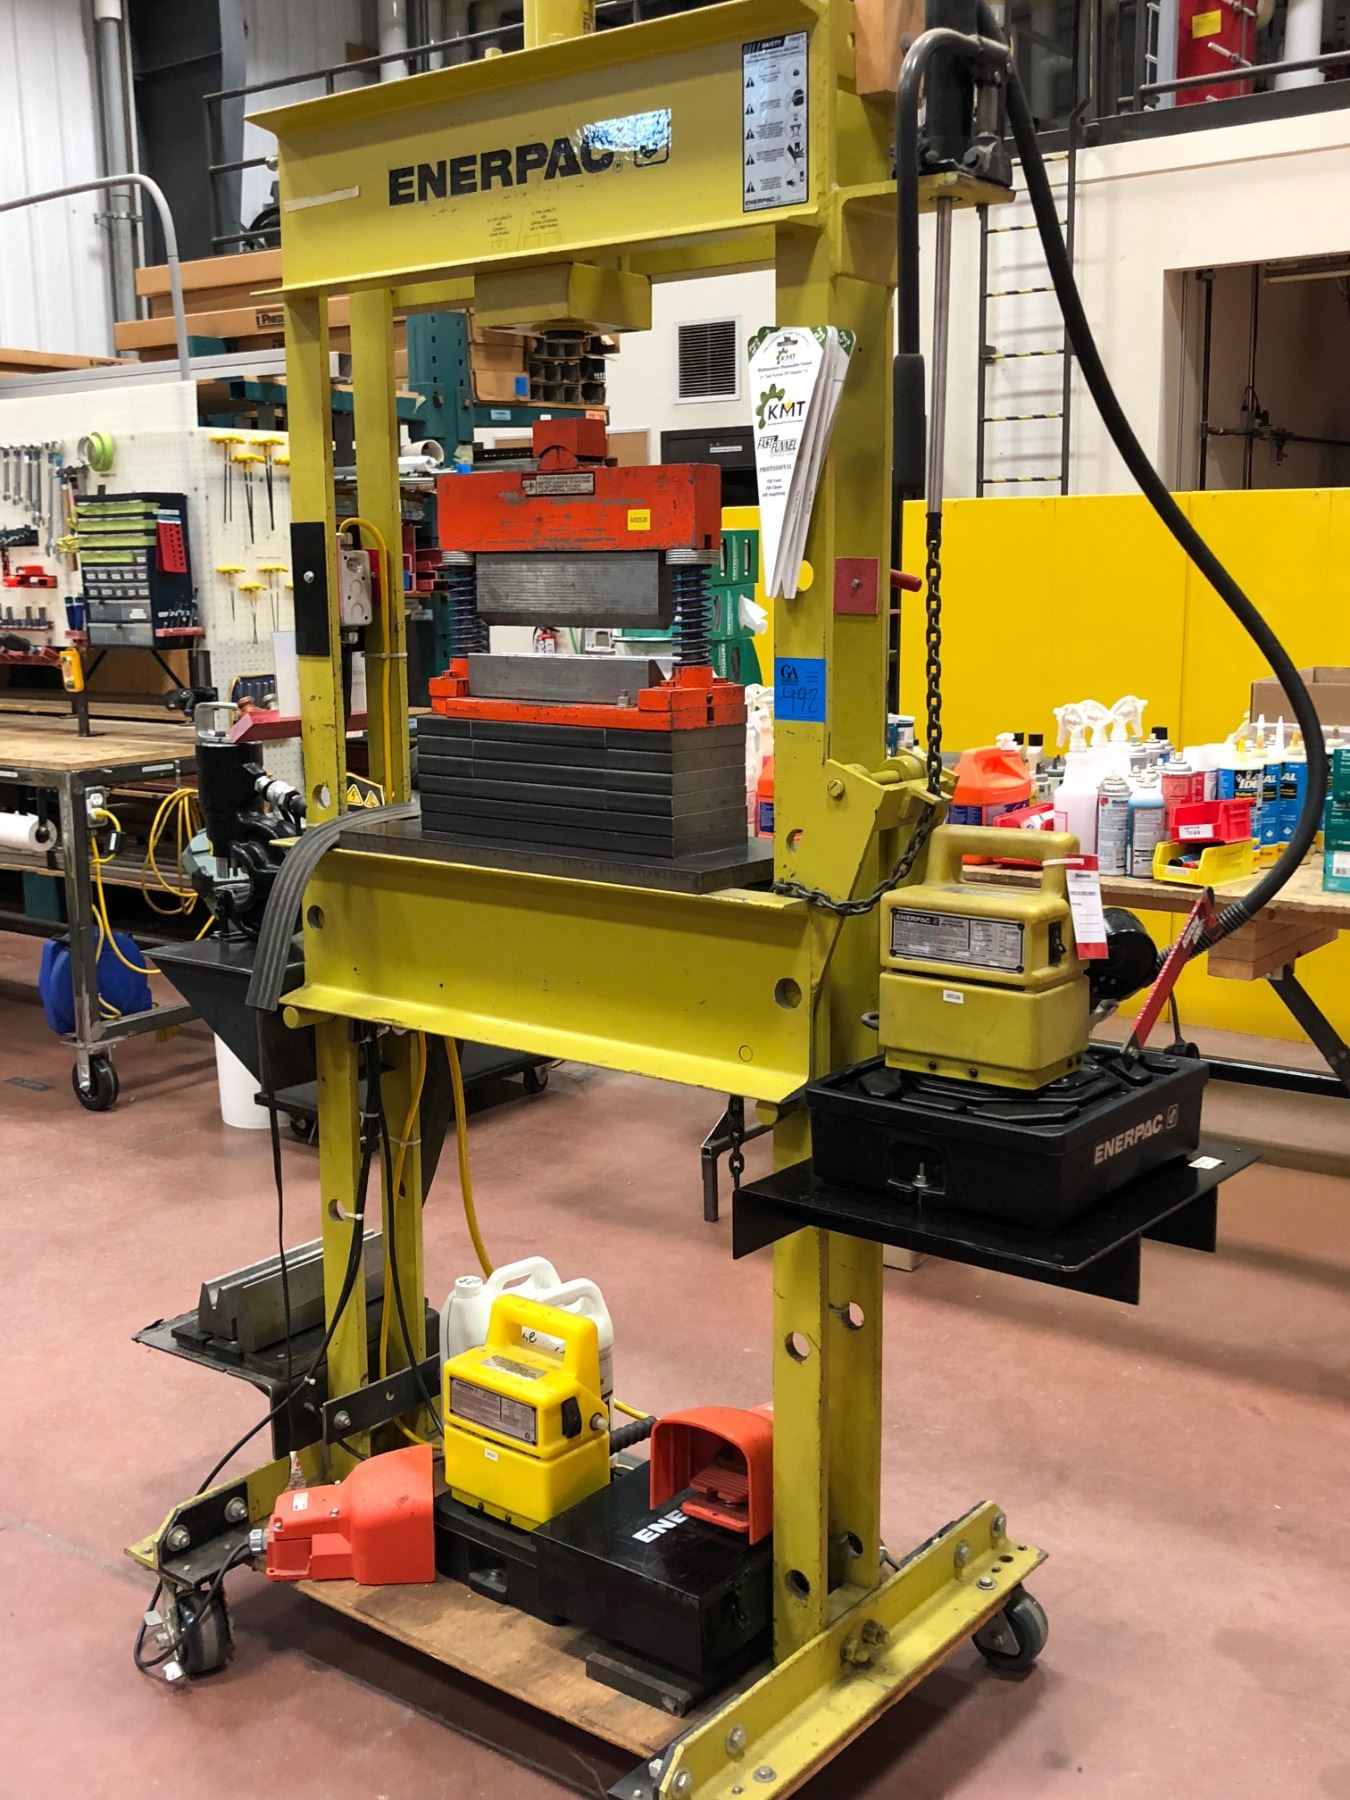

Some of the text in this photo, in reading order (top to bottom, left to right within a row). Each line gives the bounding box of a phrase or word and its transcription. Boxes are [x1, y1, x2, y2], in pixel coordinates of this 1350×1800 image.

[389, 132, 614, 206] ENERPAC
[767, 400, 806, 420] KMT
[757, 436, 776, 450] FAST
[770, 438, 798, 454] FUNNEL
[781, 664, 799, 680] GA
[1238, 778, 1263, 789] IDE
[895, 913, 932, 926] ENERPAC
[1093, 1113, 1164, 1166] ENERPAC
